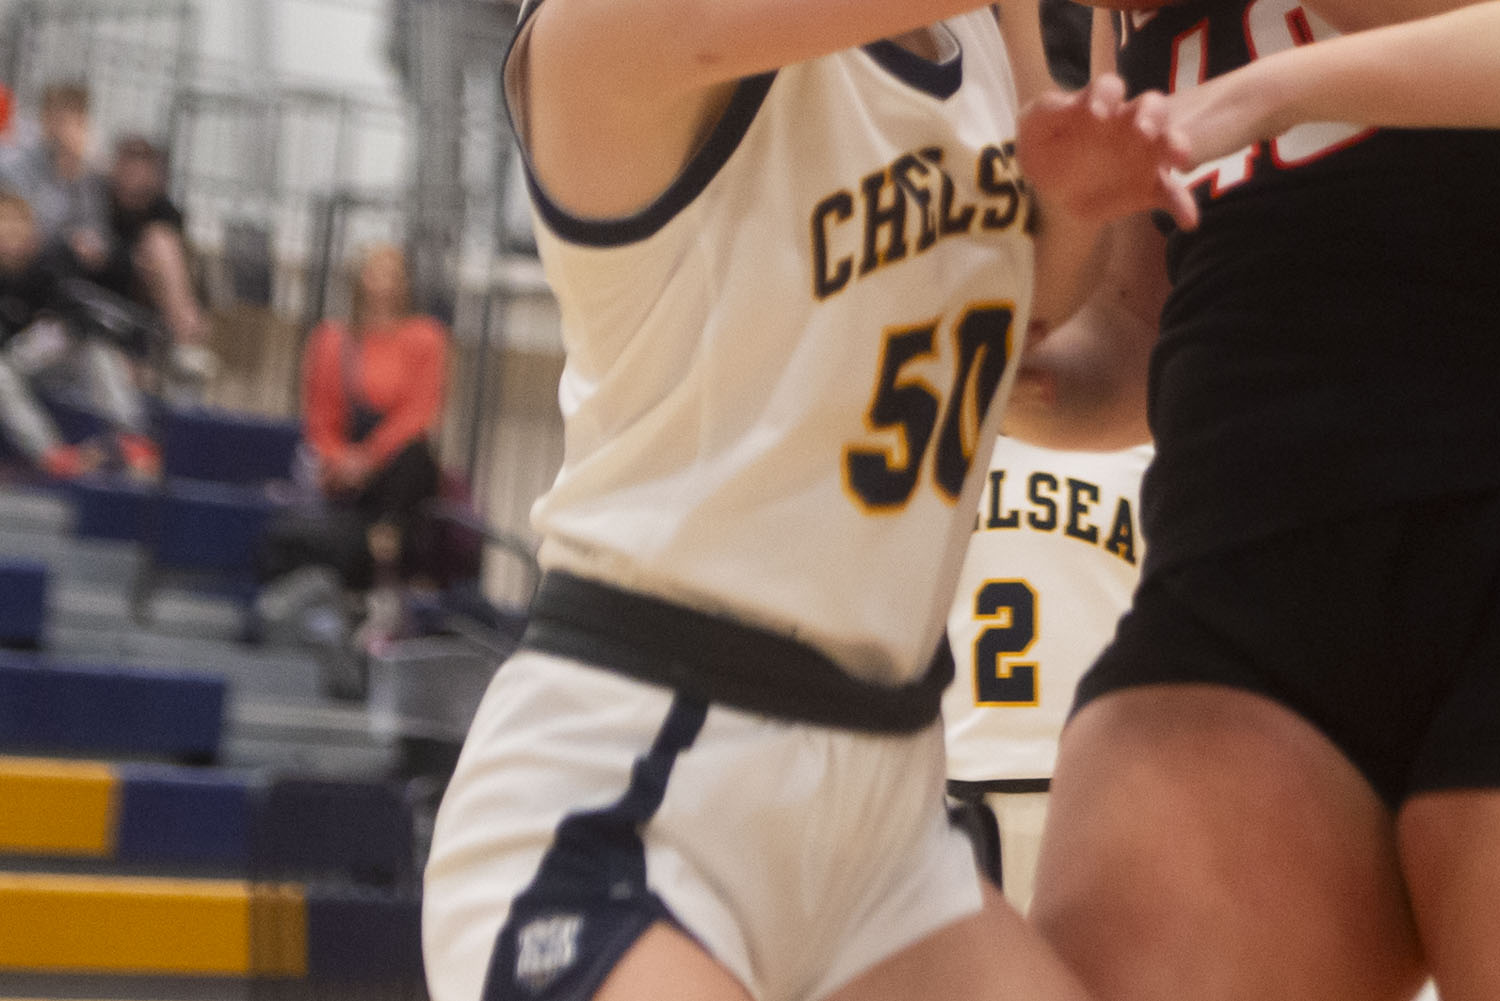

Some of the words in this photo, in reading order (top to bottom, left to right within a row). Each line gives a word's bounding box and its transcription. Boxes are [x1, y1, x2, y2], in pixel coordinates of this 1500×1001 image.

[840, 300, 1014, 516] 50
[974, 469, 1137, 567] LSEA
[972, 578, 1040, 707] 2
